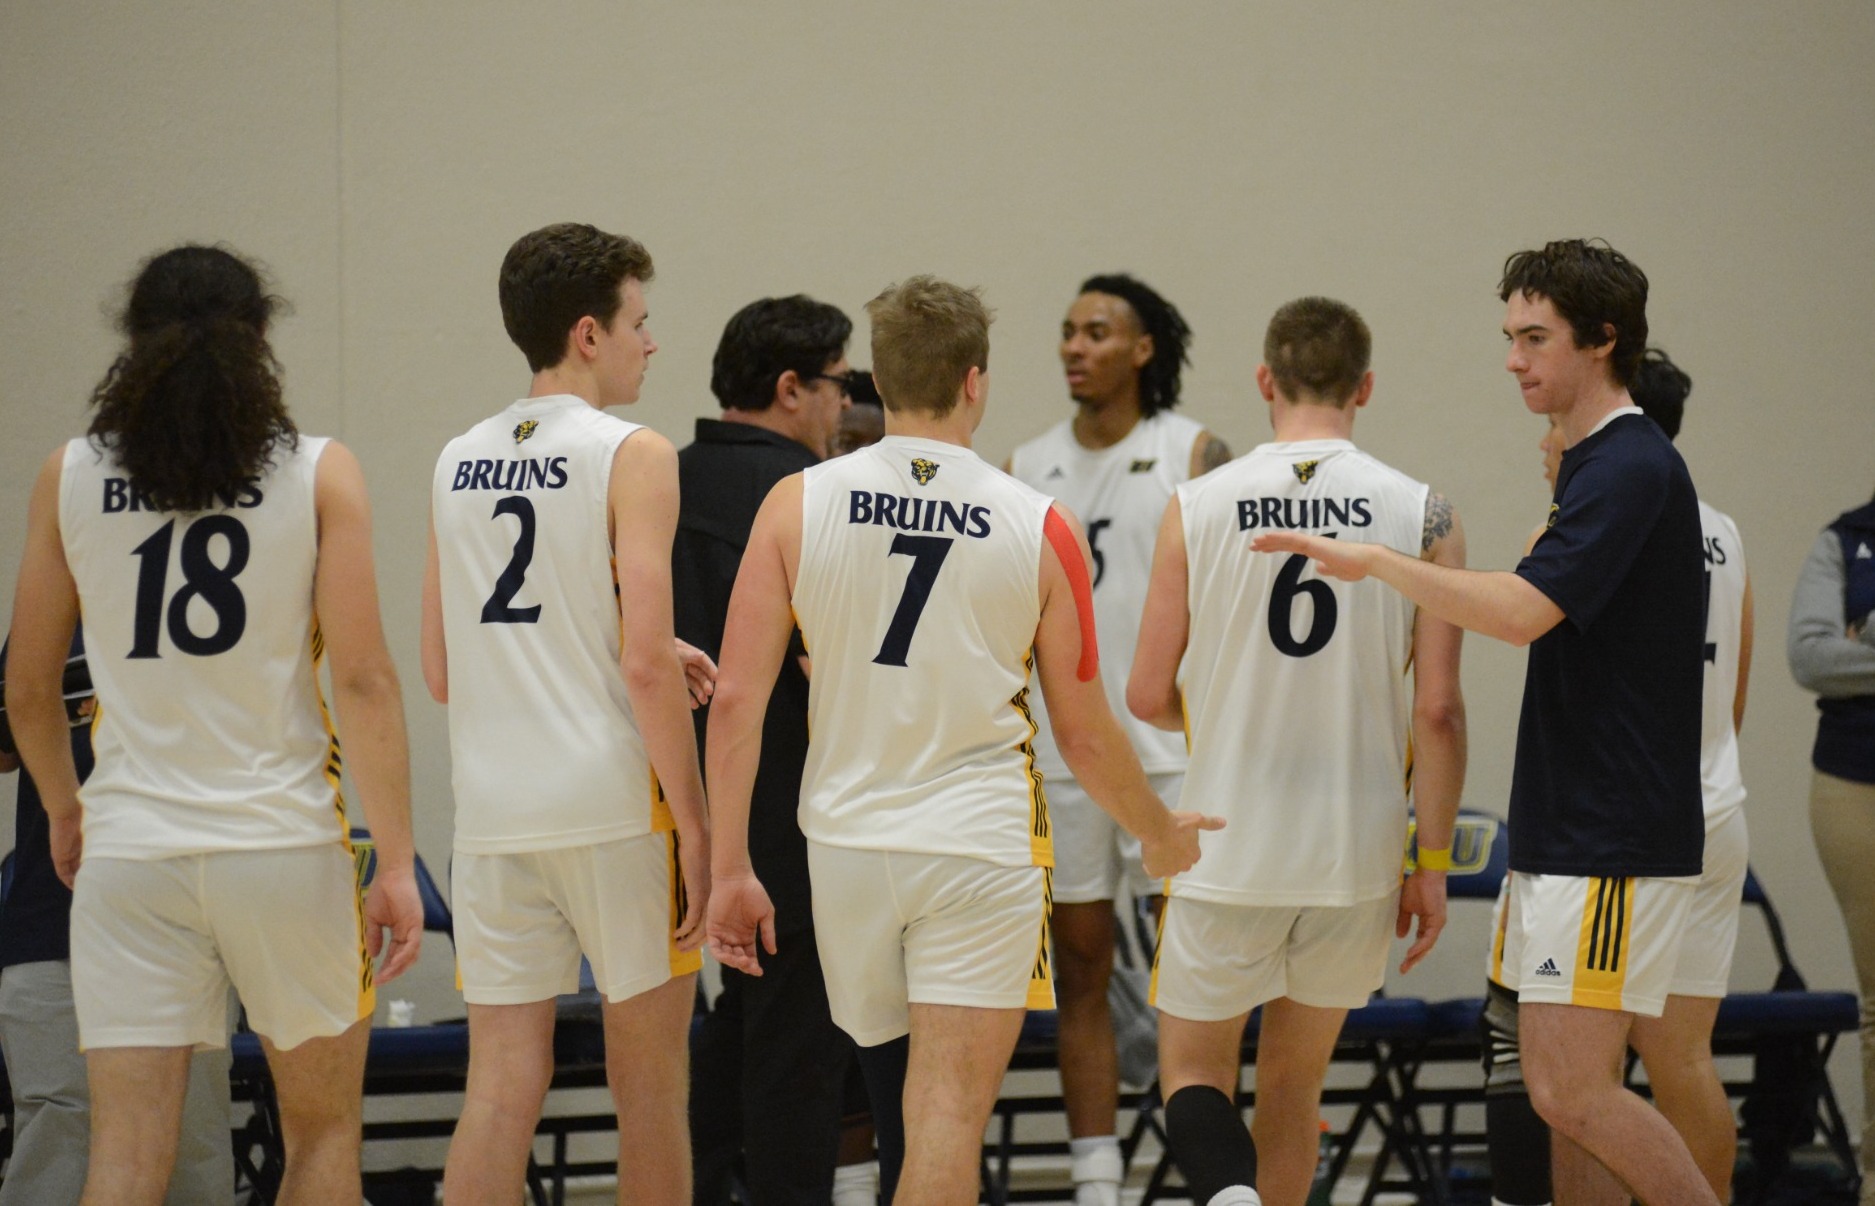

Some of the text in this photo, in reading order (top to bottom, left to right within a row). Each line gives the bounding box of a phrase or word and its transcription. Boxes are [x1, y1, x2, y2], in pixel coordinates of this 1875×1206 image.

[102, 475, 264, 514] BRNS
[451, 456, 569, 492] BRUINS
[848, 489, 992, 539] BRUINS
[1236, 497, 1373, 532] BRUINS
[479, 495, 543, 624] 2
[124, 514, 251, 660] 18
[871, 532, 955, 668] 7
[1267, 531, 1339, 659] 6
[1535, 967, 1561, 977] adidas
